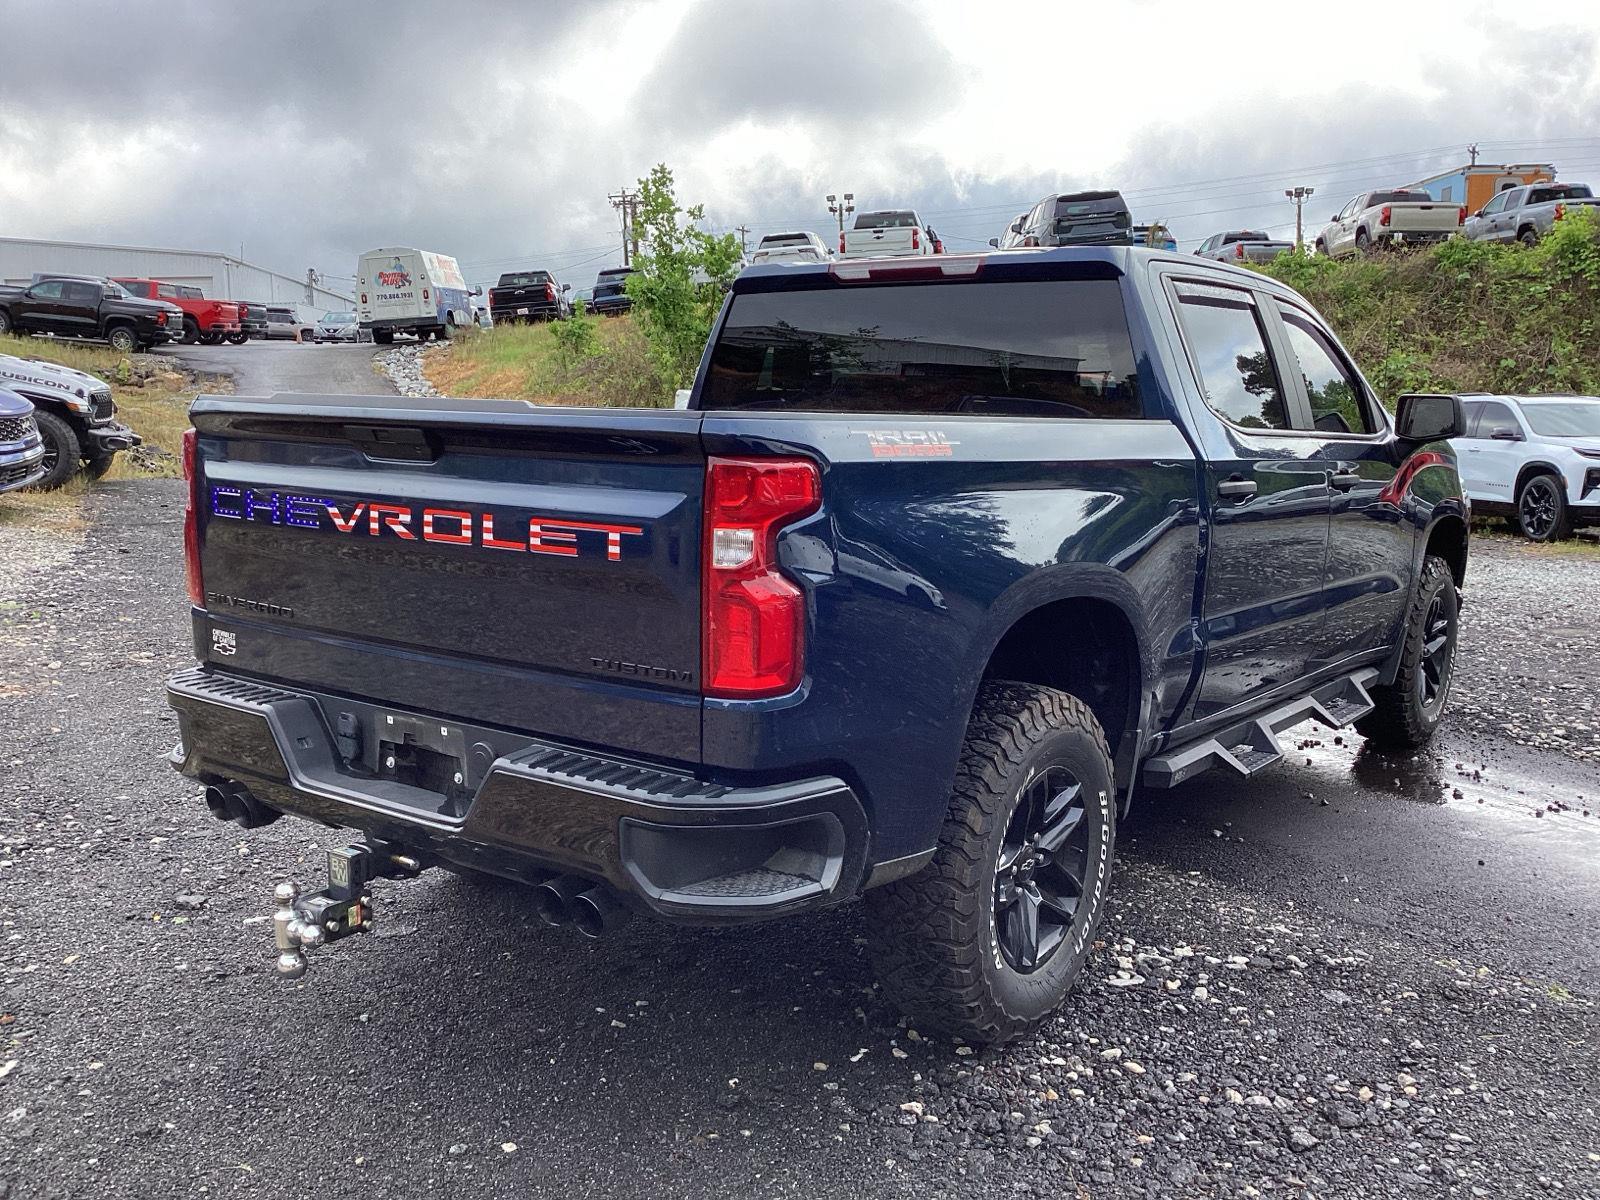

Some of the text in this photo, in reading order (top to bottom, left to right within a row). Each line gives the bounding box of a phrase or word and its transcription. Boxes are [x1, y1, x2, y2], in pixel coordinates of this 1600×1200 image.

[0, 371, 71, 391] UBICON
[850, 430, 961, 445] TRAIL
[871, 444, 953, 458] BOSS
[212, 486, 644, 562] CHEVROLET
[207, 591, 295, 618] SILVERADO
[590, 657, 693, 683] CUSTOM
